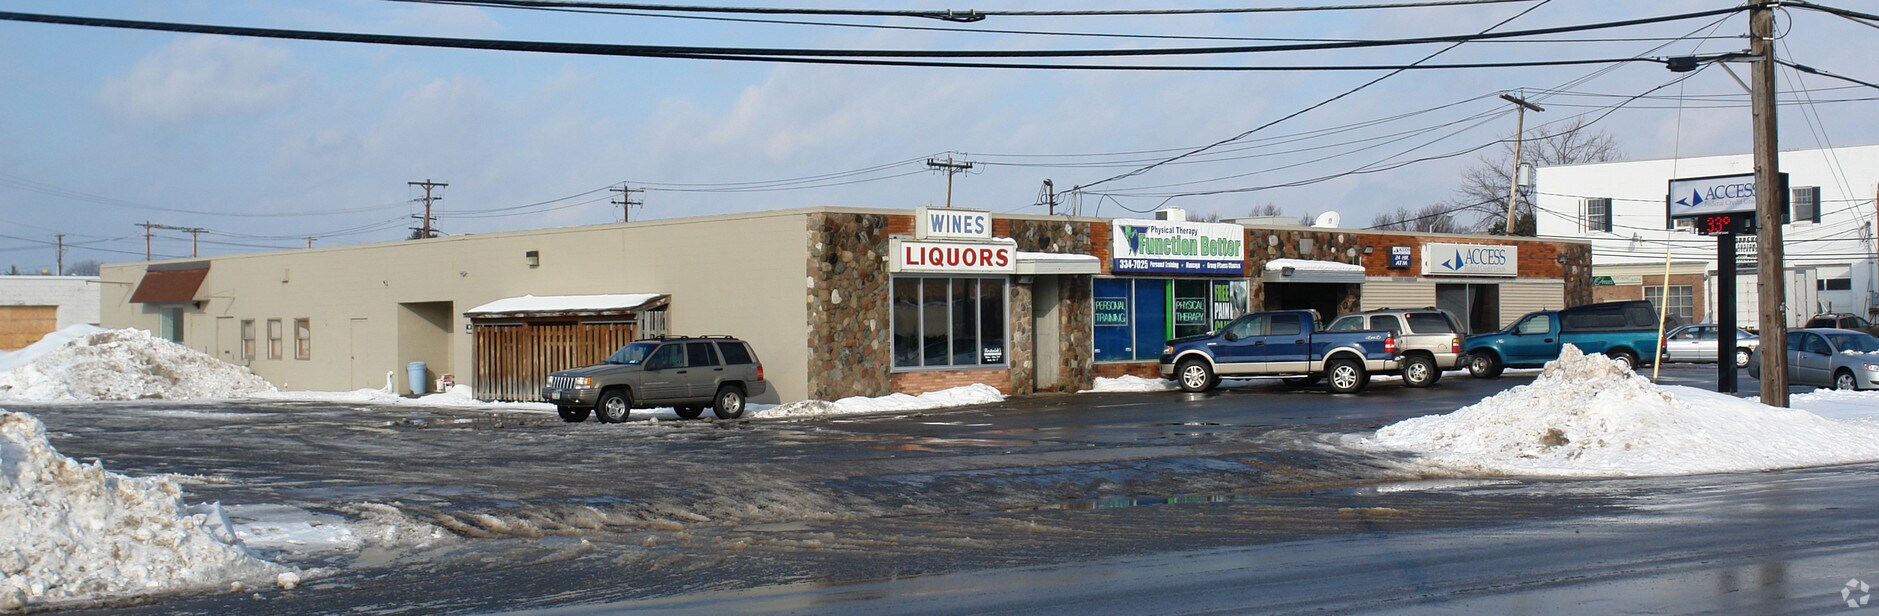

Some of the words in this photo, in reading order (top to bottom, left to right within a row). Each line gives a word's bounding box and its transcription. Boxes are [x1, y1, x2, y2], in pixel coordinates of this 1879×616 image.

[931, 214, 984, 234] WINES
[1150, 225, 1174, 235] Physical
[1175, 226, 1198, 236] Therapy
[1139, 234, 1198, 256] Function
[1200, 236, 1241, 257] Better
[906, 247, 1009, 267] LIQUORS
[1464, 248, 1507, 265] ACCESS
[1119, 259, 1149, 270] 334-7025
[1149, 260, 1165, 268] Personal
[1214, 284, 1230, 302] FREE
[1095, 301, 1126, 311] PERSONAL
[1175, 301, 1204, 311] PHYSICAL
[1214, 302, 1230, 320] PAIN
[1095, 312, 1126, 323] TRAINING
[1175, 312, 1204, 322] THERAPY
